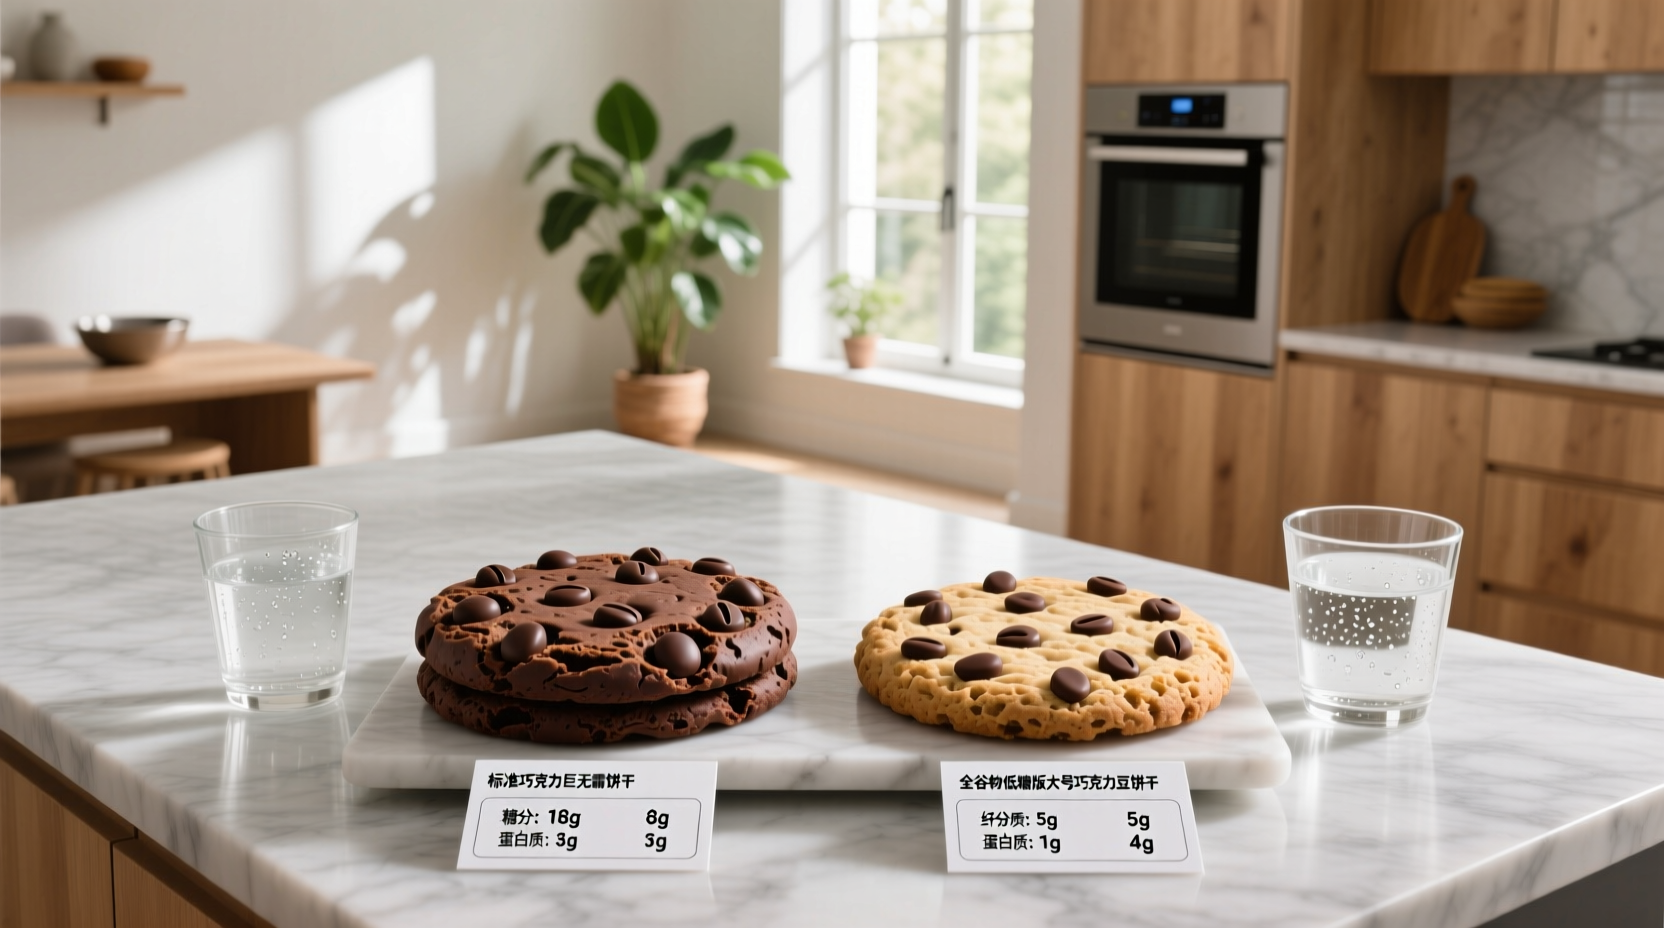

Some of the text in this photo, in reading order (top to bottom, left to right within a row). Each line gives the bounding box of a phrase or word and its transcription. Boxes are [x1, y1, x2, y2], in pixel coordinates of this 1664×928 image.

[1037, 812, 1058, 831] 5g
[1128, 812, 1150, 832] 5g
[556, 832, 578, 852] 3g
[1039, 834, 1061, 854] 1g
[1130, 834, 1154, 855] 4g
